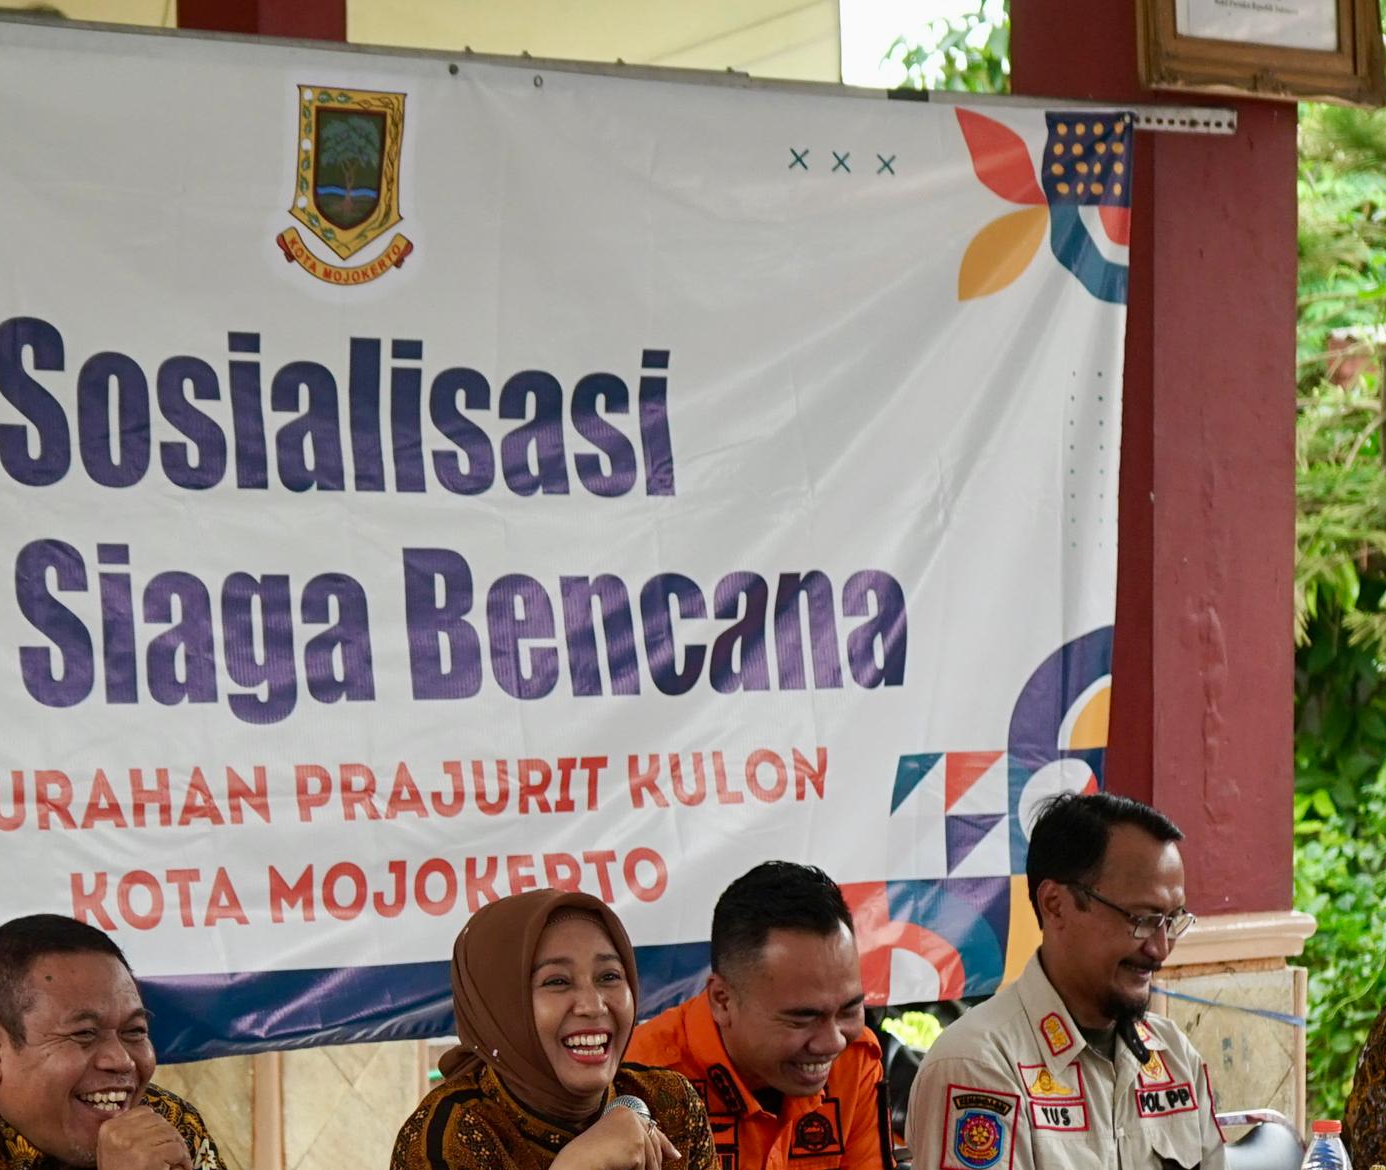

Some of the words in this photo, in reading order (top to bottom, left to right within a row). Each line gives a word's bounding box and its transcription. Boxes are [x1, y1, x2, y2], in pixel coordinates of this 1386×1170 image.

[288, 235, 318, 273] KOTA
[322, 243, 400, 282] MOJOKERTO
[16, 538, 376, 725] Siaga
[402, 547, 909, 701] Bencana
[294, 755, 609, 824] PRAJURIT
[625, 746, 828, 811] KULON
[69, 866, 249, 931] KOTA
[1041, 1107, 1071, 1126] YUS
[1139, 1092, 1165, 1113] POL
[1166, 1088, 1190, 1108] PP
